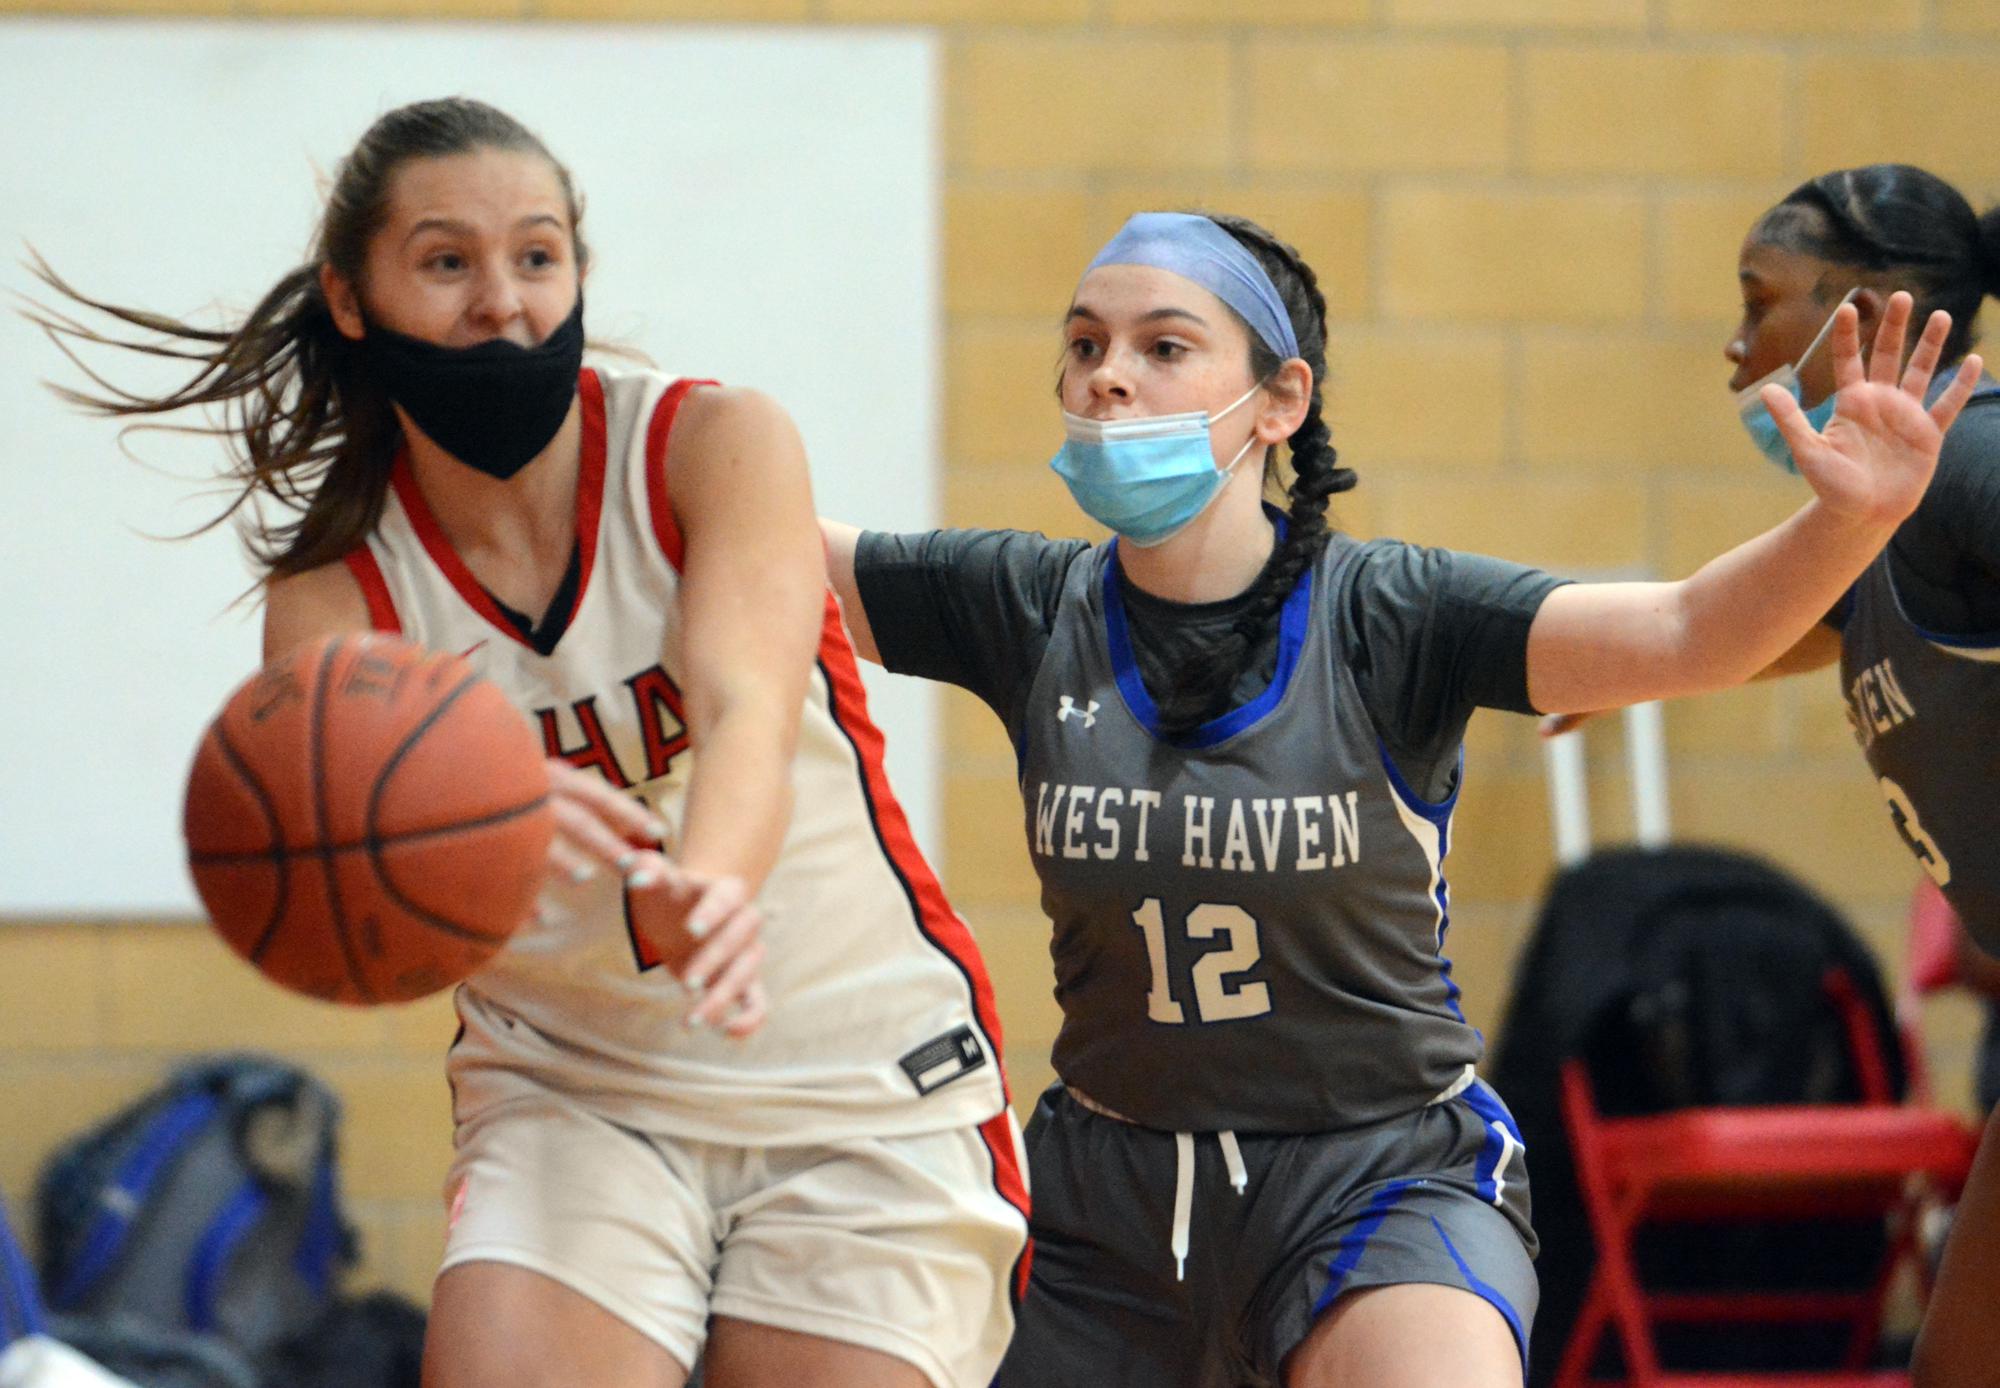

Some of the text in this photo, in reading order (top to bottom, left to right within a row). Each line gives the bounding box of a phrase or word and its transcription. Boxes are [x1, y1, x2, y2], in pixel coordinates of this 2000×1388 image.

[1035, 782, 1360, 872] WEST HAVEN
[1132, 897, 1271, 1024] 12
